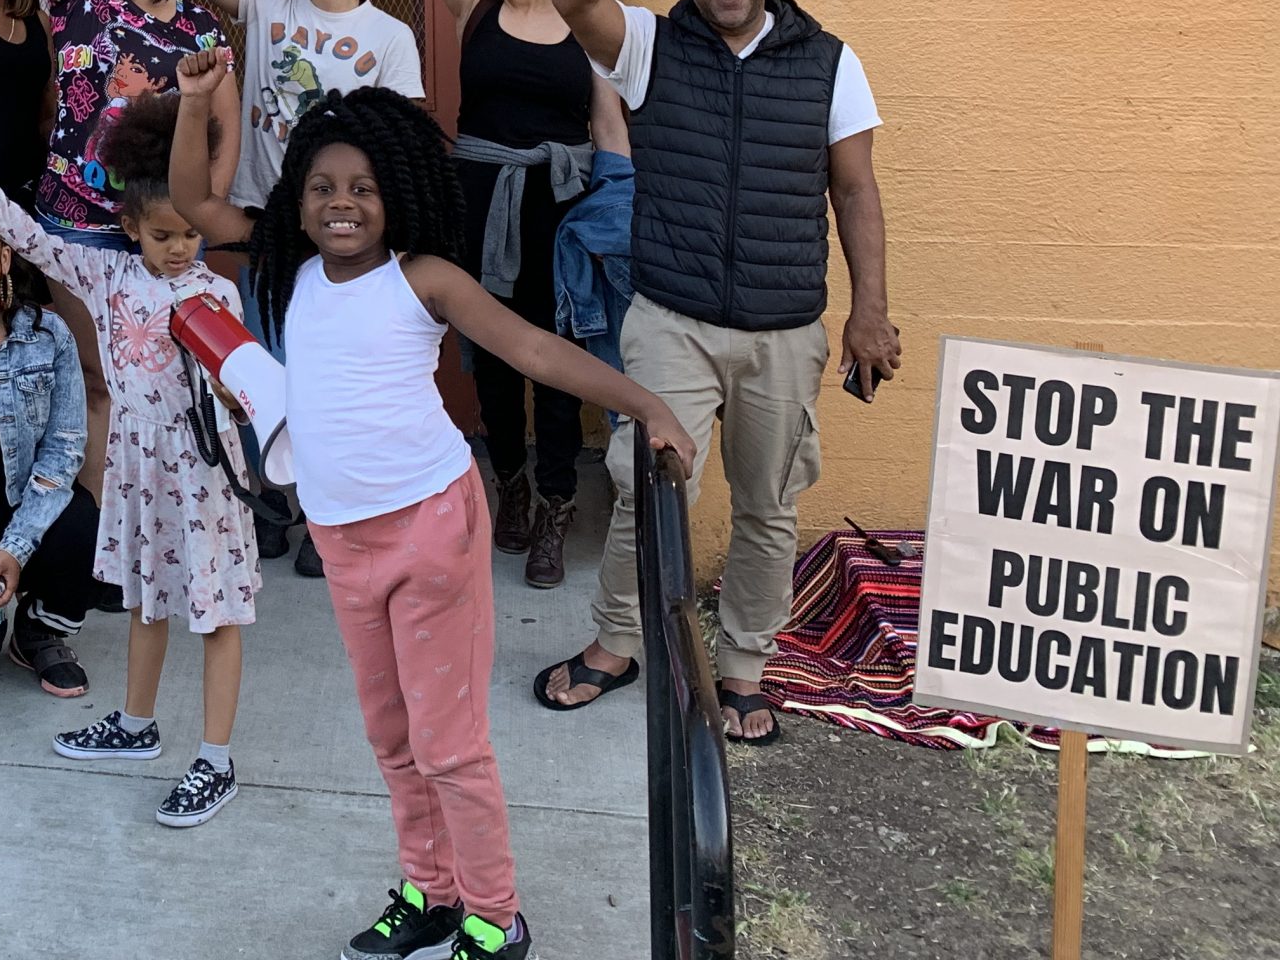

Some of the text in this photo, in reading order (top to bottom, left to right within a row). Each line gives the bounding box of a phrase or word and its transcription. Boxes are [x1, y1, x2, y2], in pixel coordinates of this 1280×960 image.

[270, 22, 377, 77] BAYOU
[960, 369, 1257, 472] STOP THE
[976, 449, 1227, 550] WAR ON
[988, 548, 1190, 637] PUBLIC
[927, 609, 1240, 716] EDUCATION
